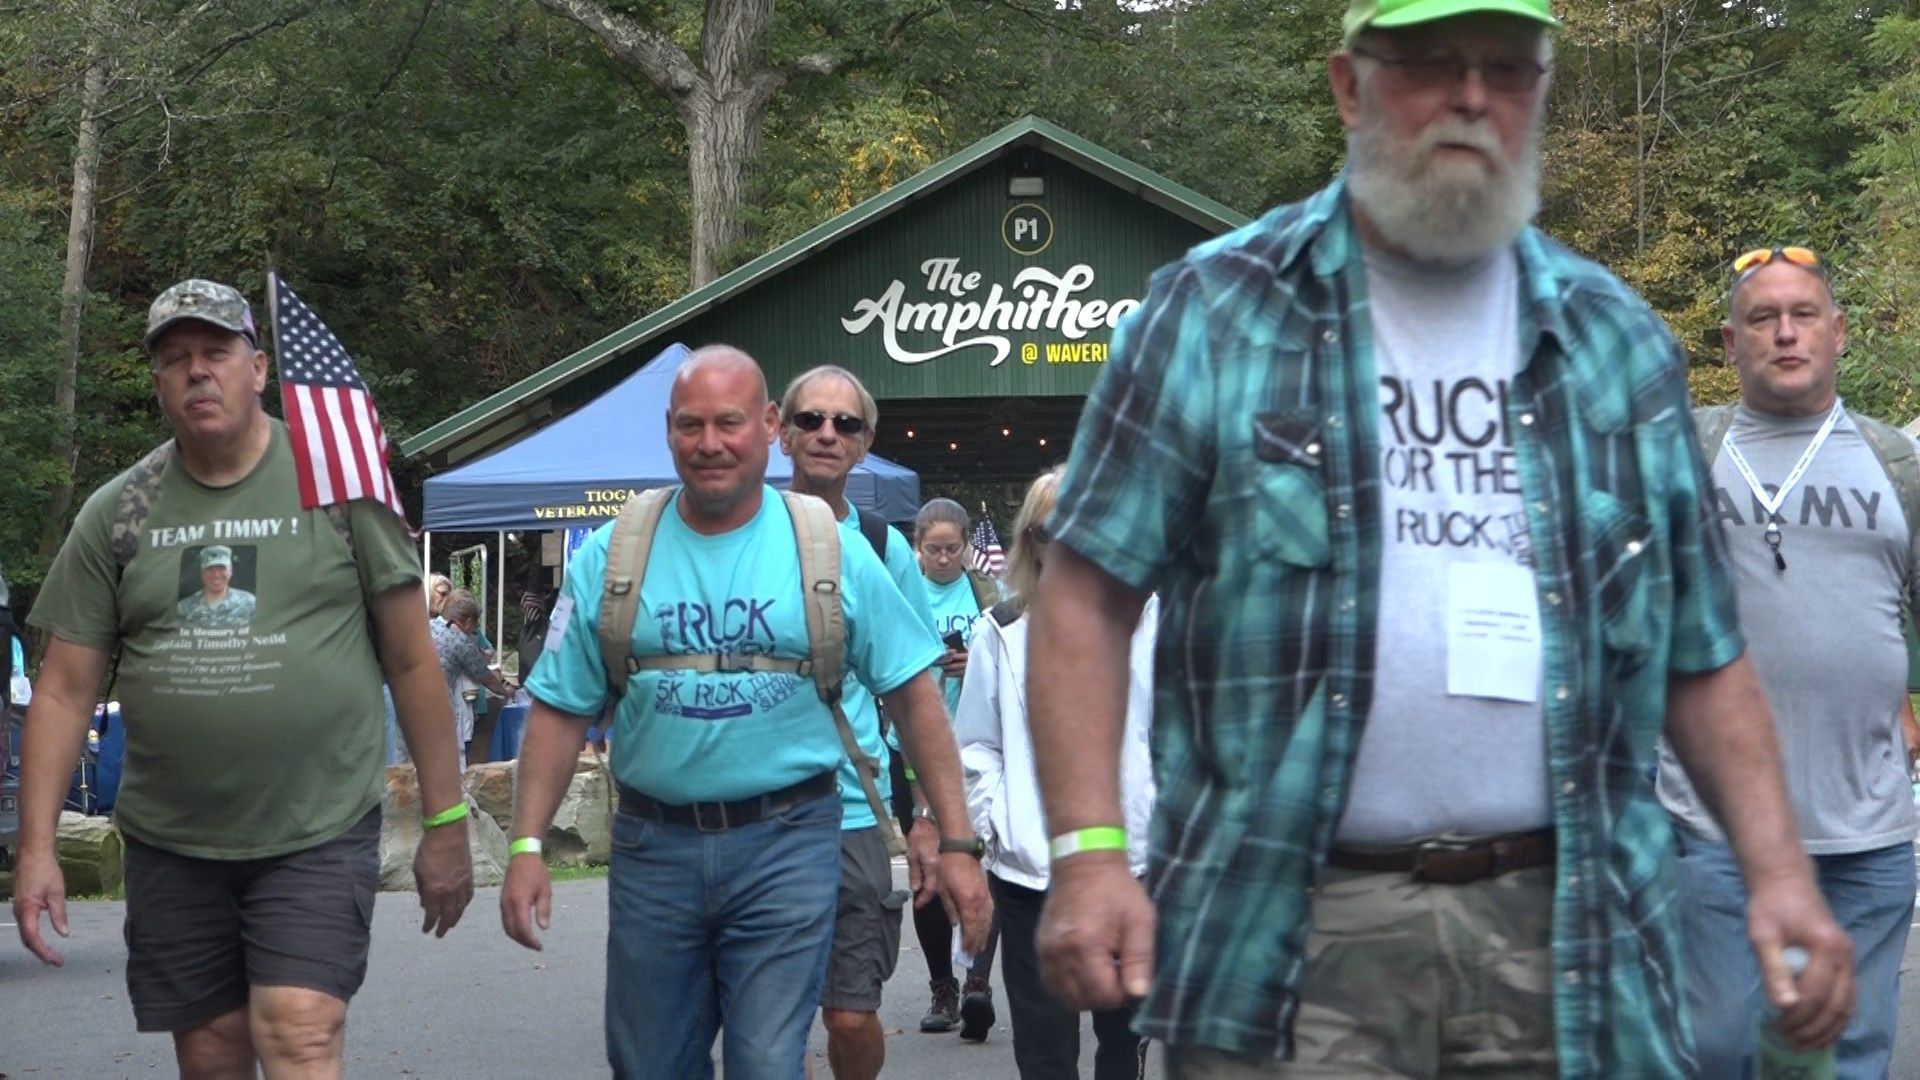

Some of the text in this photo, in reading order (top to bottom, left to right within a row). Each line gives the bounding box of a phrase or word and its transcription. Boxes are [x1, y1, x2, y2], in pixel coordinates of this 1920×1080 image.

[1014, 217, 1038, 242] P1
[920, 257, 982, 297] The
[841, 264, 1142, 366] Amphithea
[1021, 342, 1108, 365] @ WAVER
[1384, 446, 1523, 495] OR THE
[585, 489, 638, 502] TIOGA
[1701, 482, 1881, 530] ARMY
[149, 525, 206, 548] TEAM
[212, 517, 284, 539] TIMMY
[1396, 508, 1497, 550] RUCK
[677, 598, 777, 647] RUCK
[936, 612, 980, 635] UCK
[196, 637, 248, 651] Timothy
[656, 679, 684, 703] 5K
[695, 679, 749, 706] RCK
